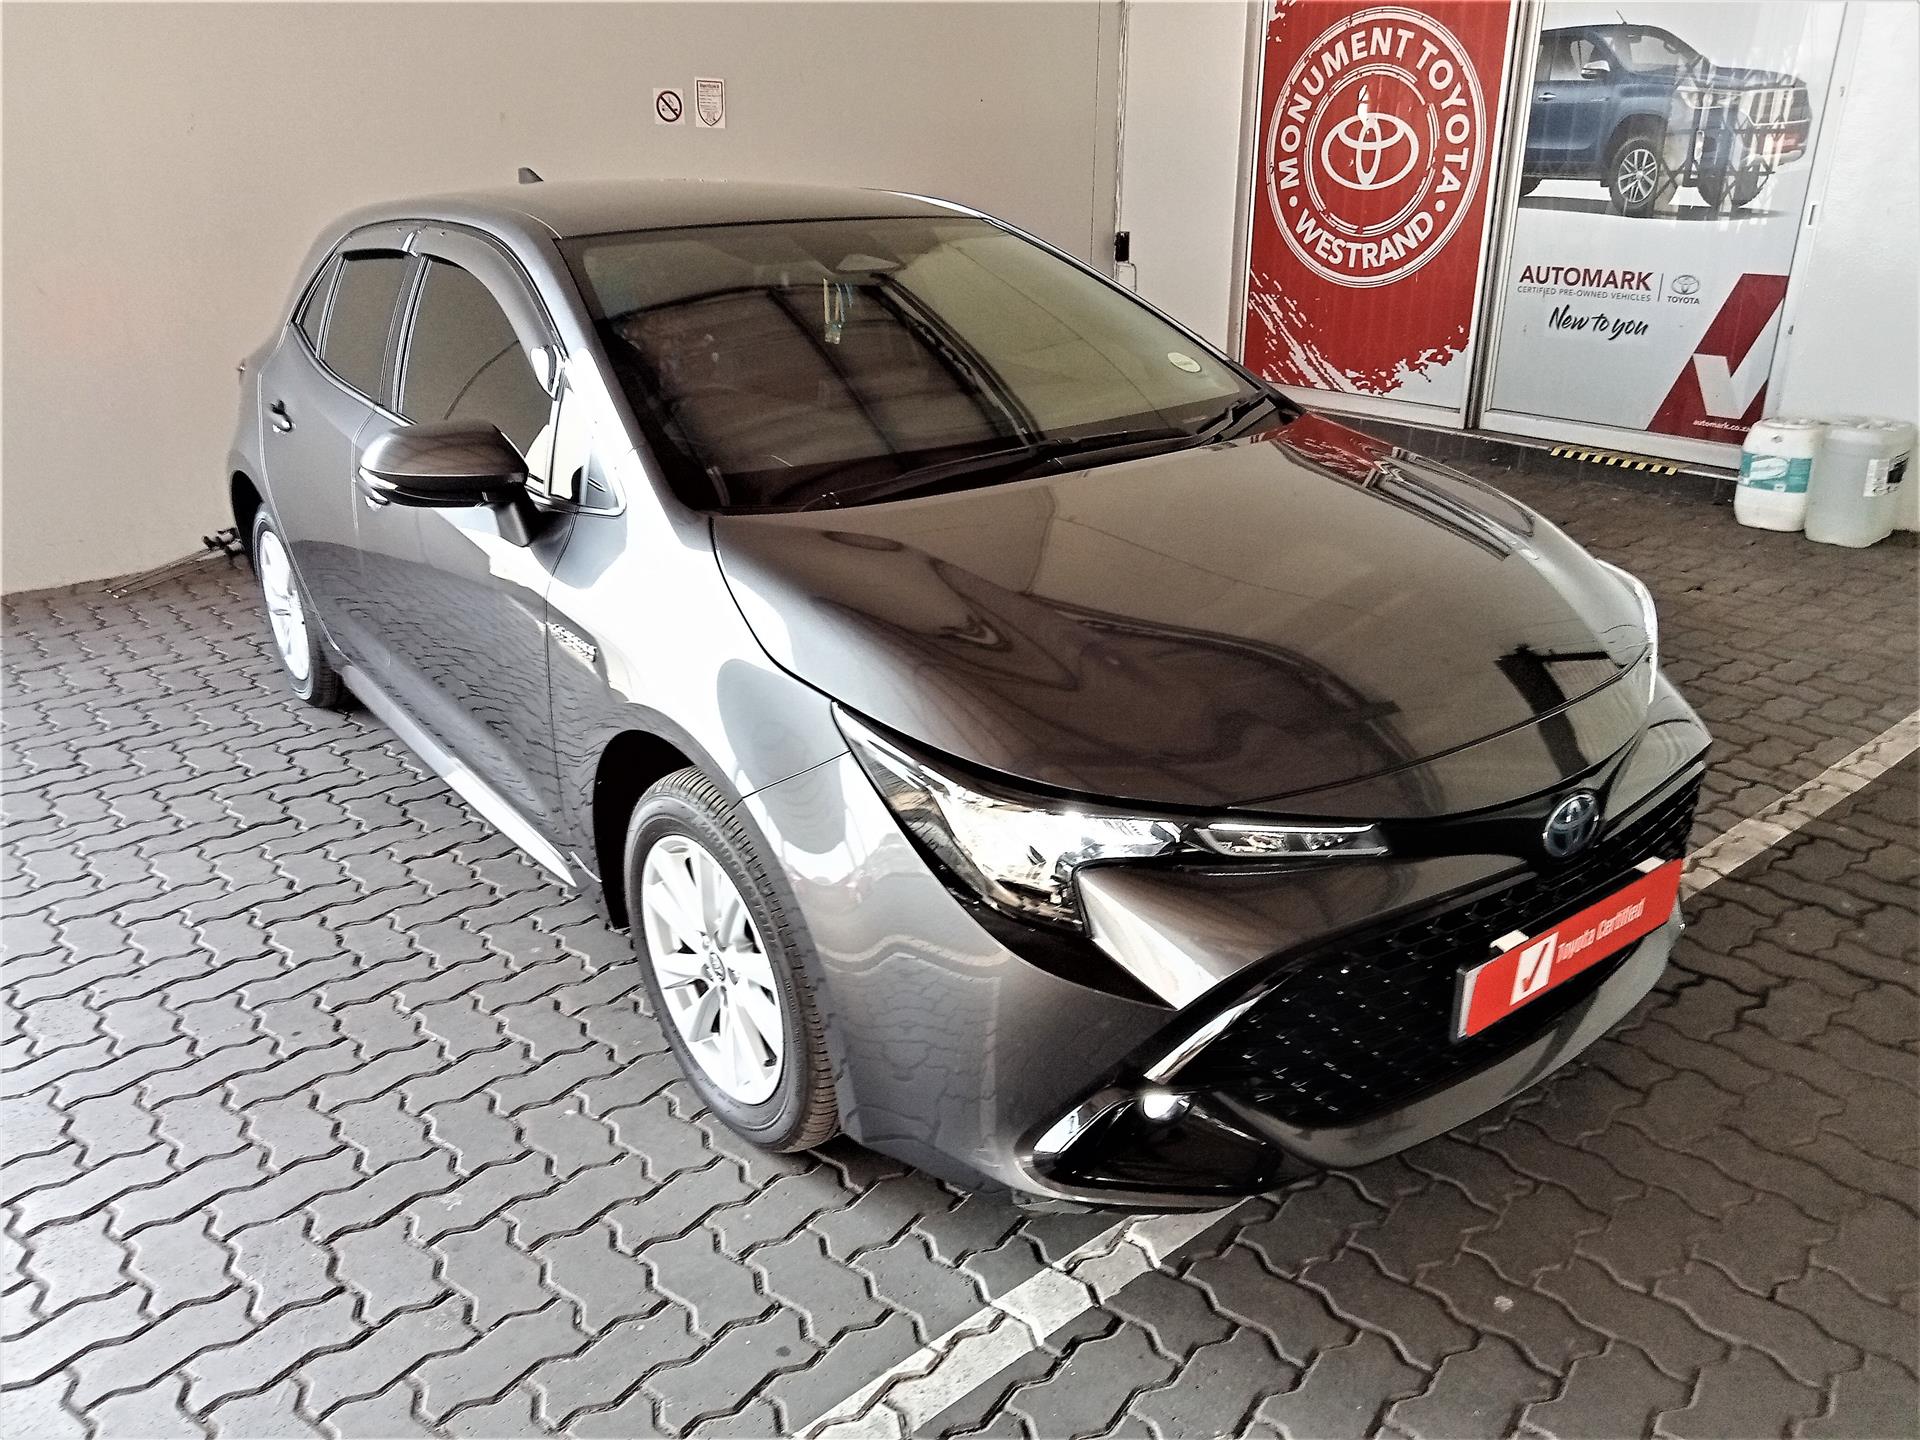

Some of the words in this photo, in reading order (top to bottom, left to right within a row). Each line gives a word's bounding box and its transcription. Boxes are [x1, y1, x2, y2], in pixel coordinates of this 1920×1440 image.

[1278, 27, 1415, 189] MONUMENT
[1416, 39, 1470, 194] TOYOTA
[1295, 208, 1434, 269] WESTRAND
[1517, 285, 1556, 295] CERTIFIED
[1559, 288, 1608, 299] PRE-OWNED
[1611, 293, 1651, 302] VEHICLES
[1519, 265, 1653, 291] AUTOMARK
[1667, 295, 1700, 304] TOYOTA
[1549, 304, 1589, 331] New
[1591, 313, 1609, 331] to
[1608, 318, 1649, 341] you
[1556, 929, 1596, 963] Toyota
[1596, 897, 1646, 940] Certified
